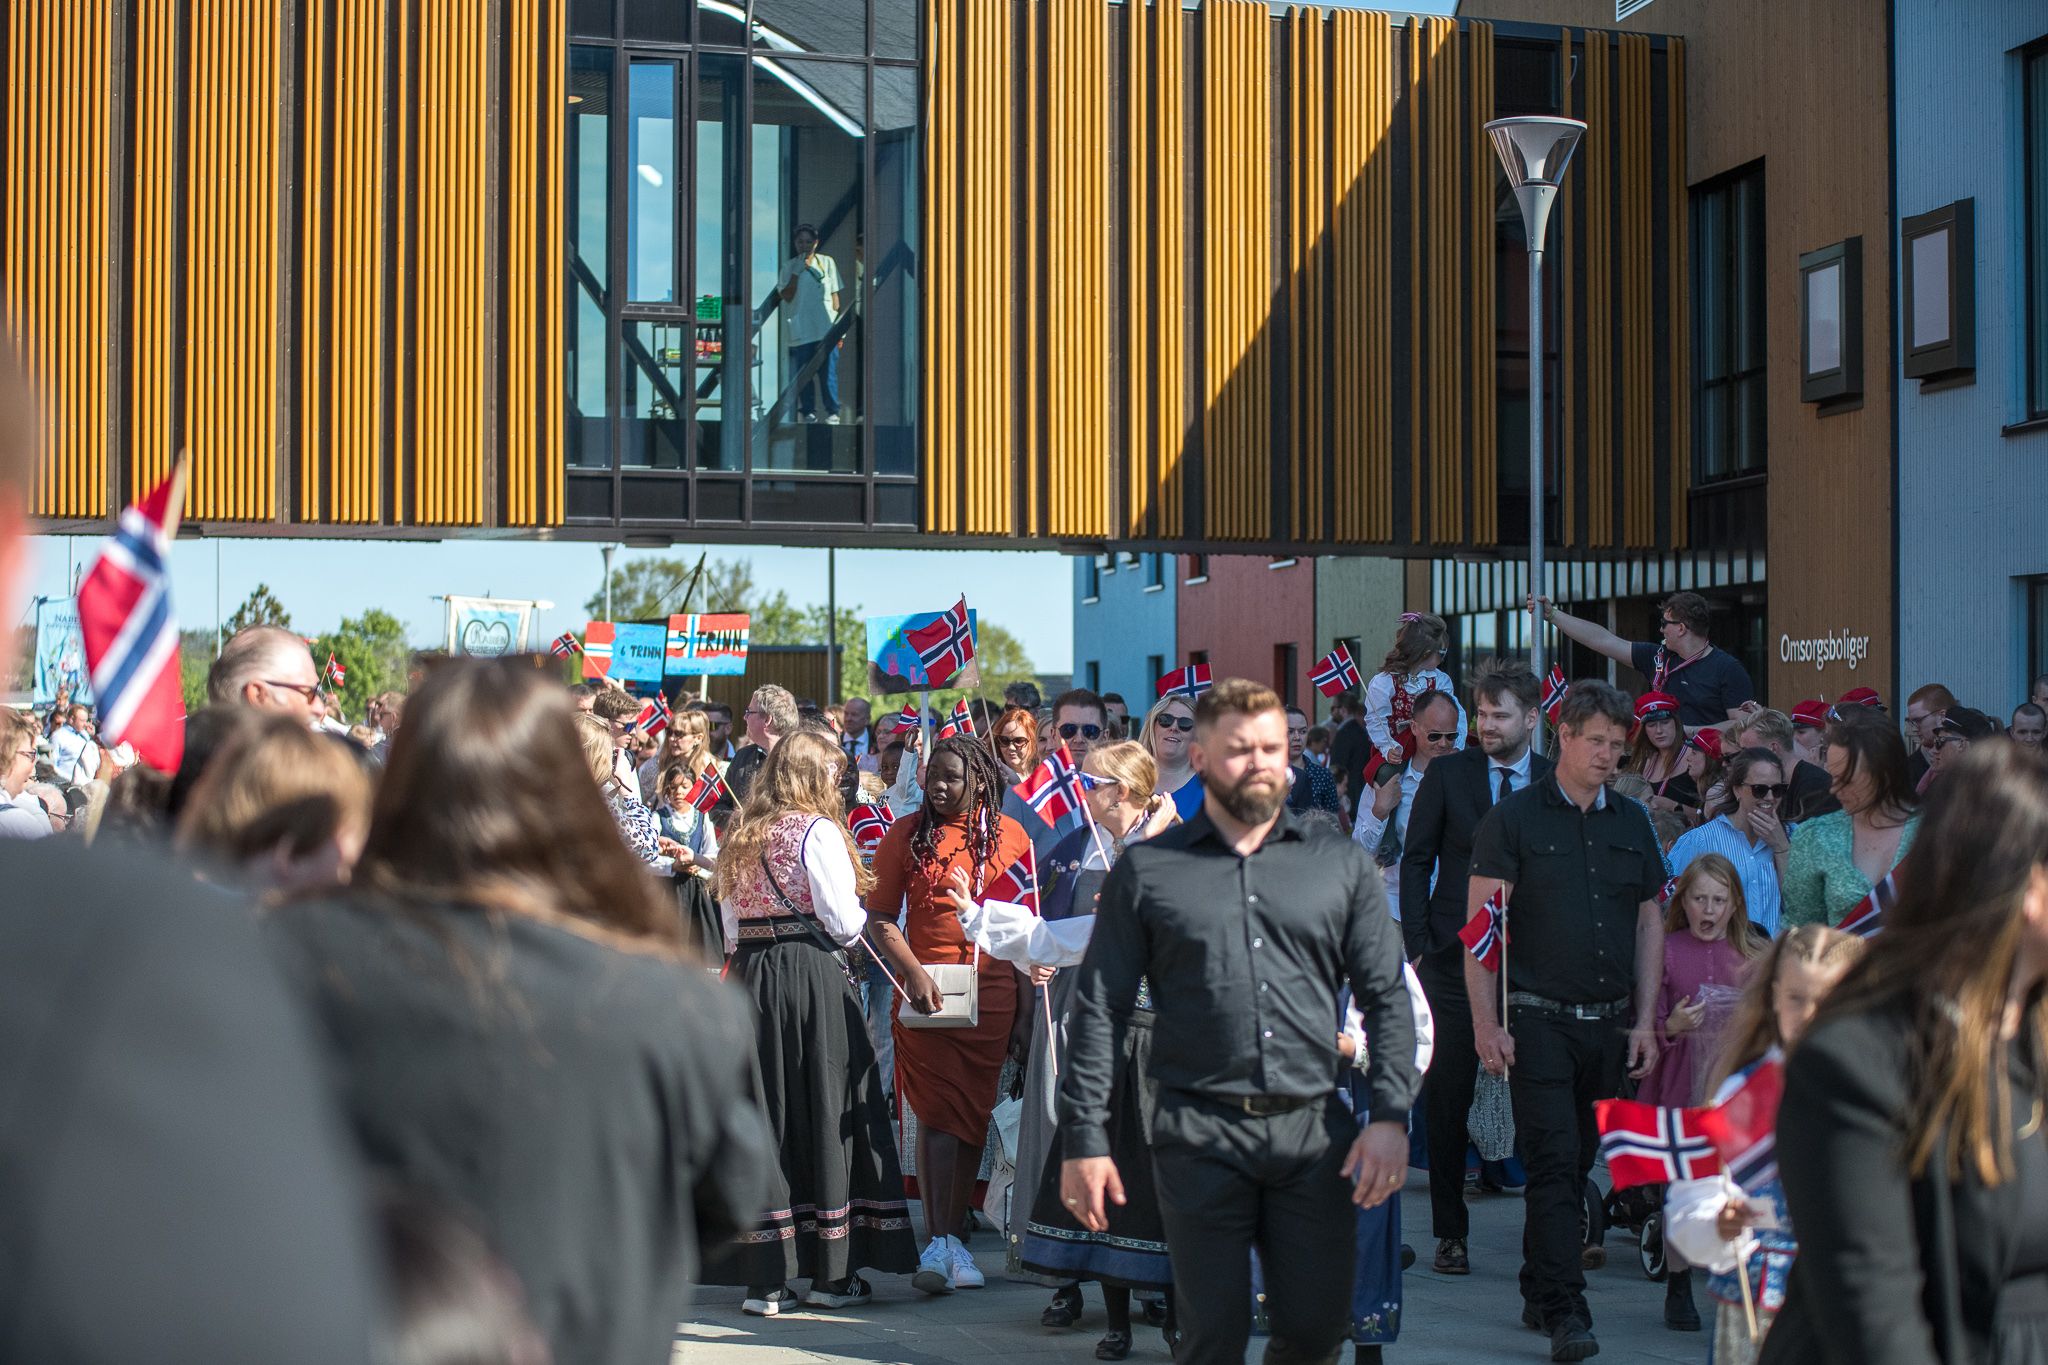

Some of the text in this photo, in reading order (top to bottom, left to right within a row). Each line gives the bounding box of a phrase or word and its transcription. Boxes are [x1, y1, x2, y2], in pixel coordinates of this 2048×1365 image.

[675, 629, 743, 652] 5 TRINN
[1780, 627, 1869, 671] Omsorgsboliger
[620, 645, 662, 660] 6 TRINN
